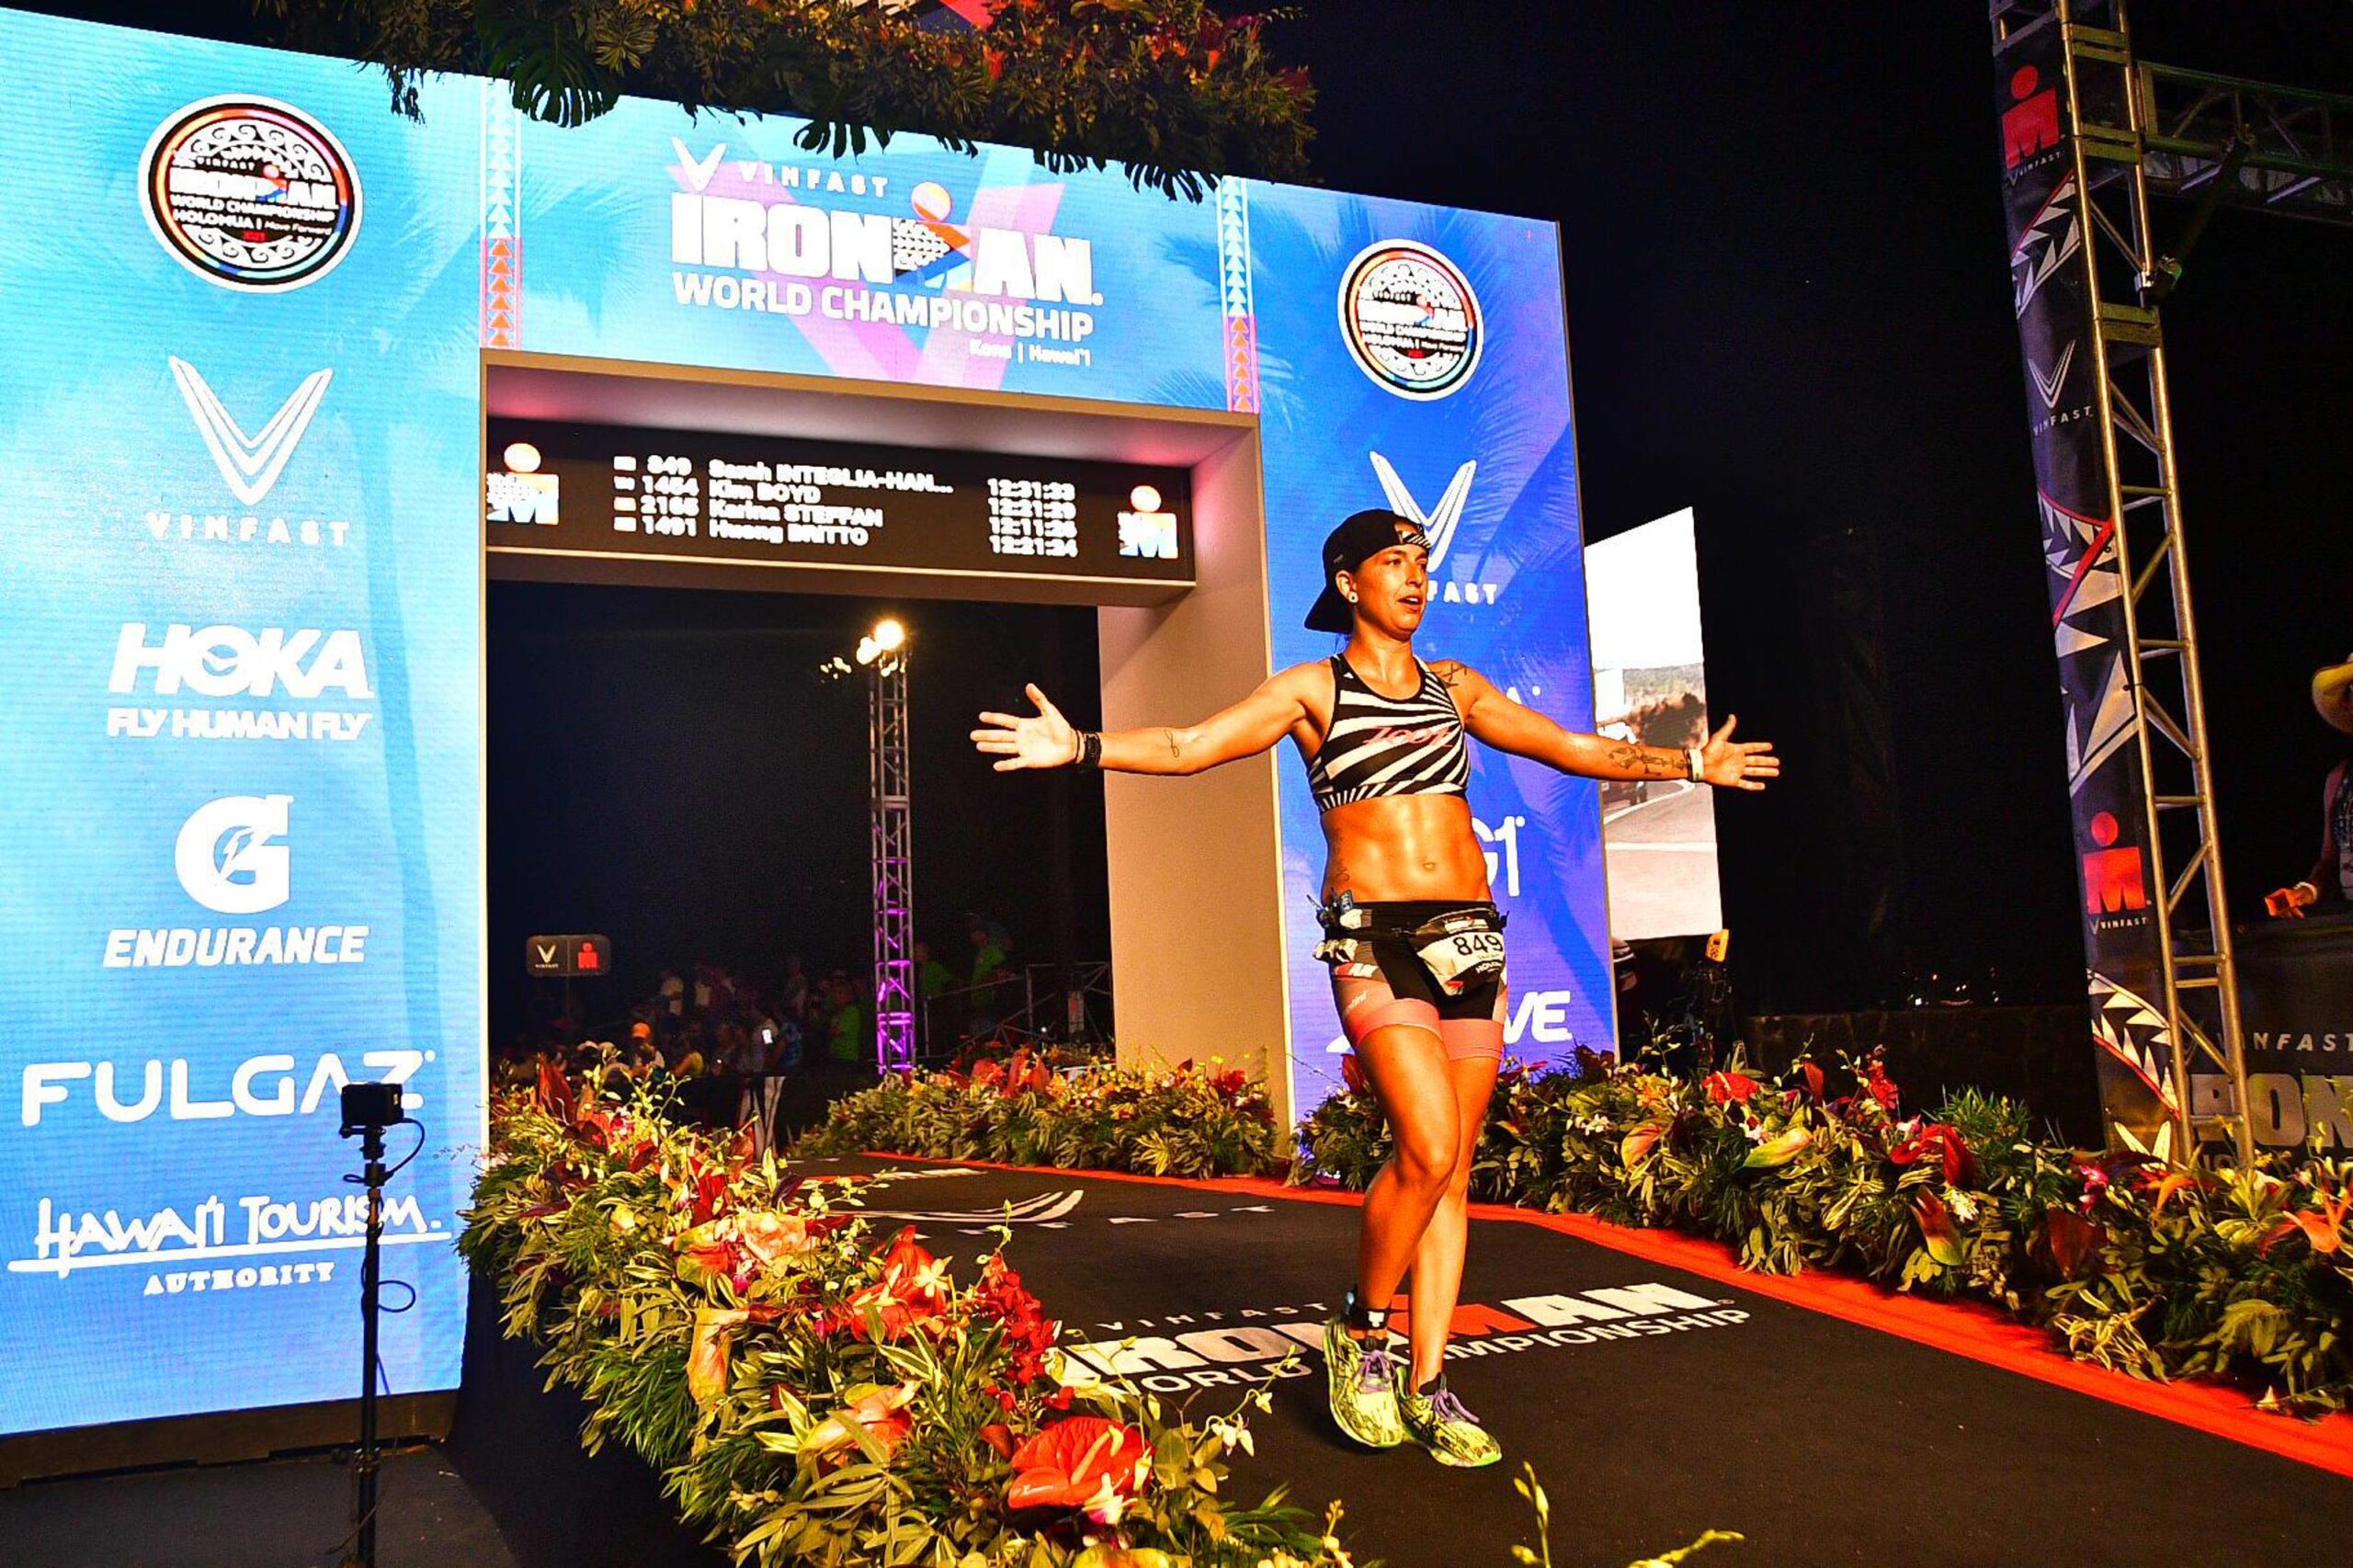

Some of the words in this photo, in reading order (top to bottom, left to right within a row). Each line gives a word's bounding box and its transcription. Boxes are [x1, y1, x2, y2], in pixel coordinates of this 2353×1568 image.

[737, 160, 889, 199] VINFAST
[671, 272, 813, 316] WORLD
[821, 285, 1094, 343] CHAMPIONSHIP
[145, 511, 351, 547] VINFAST
[1427, 580, 1498, 605] FAST
[108, 621, 375, 699] HOKA
[107, 708, 171, 738] FLY
[172, 709, 310, 740] HUMAN
[311, 711, 374, 741] FLY
[102, 926, 370, 969] ENDURANCE
[1453, 934, 1504, 956] 849
[2253, 1032, 2353, 1051] NFAST
[22, 1050, 426, 1126] FULGAZ
[143, 1262, 335, 1296] AUTHORITY
[1096, 1302, 1329, 1331] VINFAST
